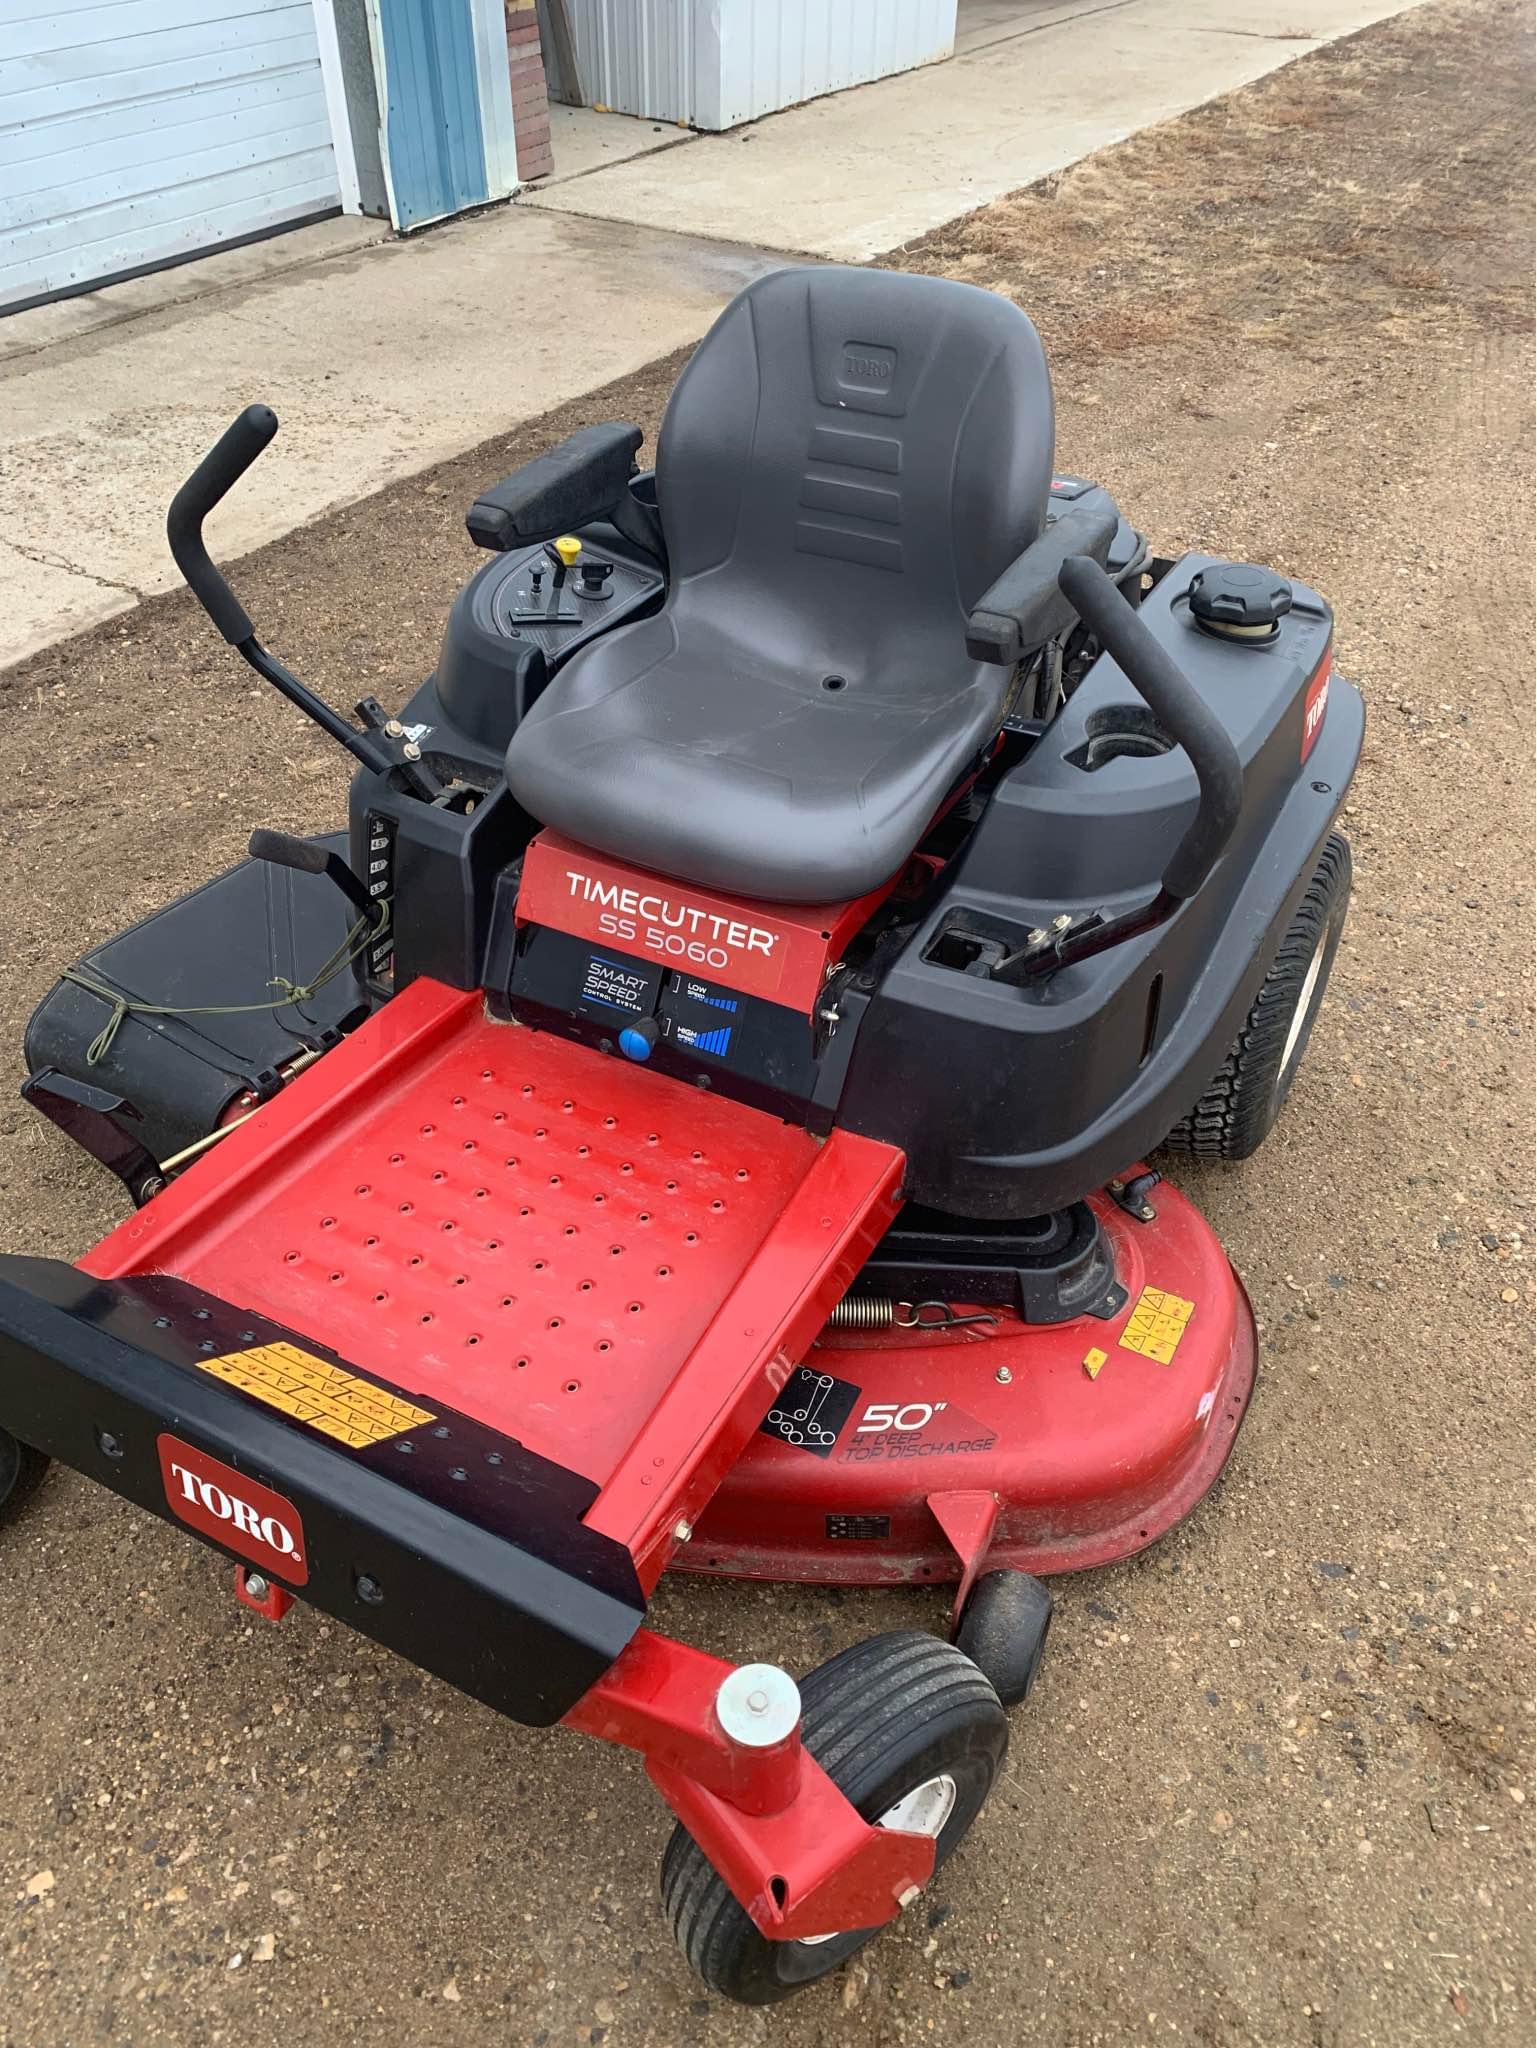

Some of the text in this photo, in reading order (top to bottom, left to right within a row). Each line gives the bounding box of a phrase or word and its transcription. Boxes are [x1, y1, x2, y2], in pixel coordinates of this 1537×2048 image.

[566, 871, 771, 956] TIMECUTTER
[598, 913, 728, 968] SS 5060
[585, 975, 638, 1001] SPEED
[587, 962, 649, 991] SMART
[687, 982, 707, 994] LOW
[583, 987, 642, 1011] CONTROL SYSTEM
[677, 1026, 698, 1038] HIGH
[856, 1402, 948, 1432] 50"
[846, 1438, 996, 1461] TOP DISCHARGE
[874, 1432, 922, 1446] DEEP
